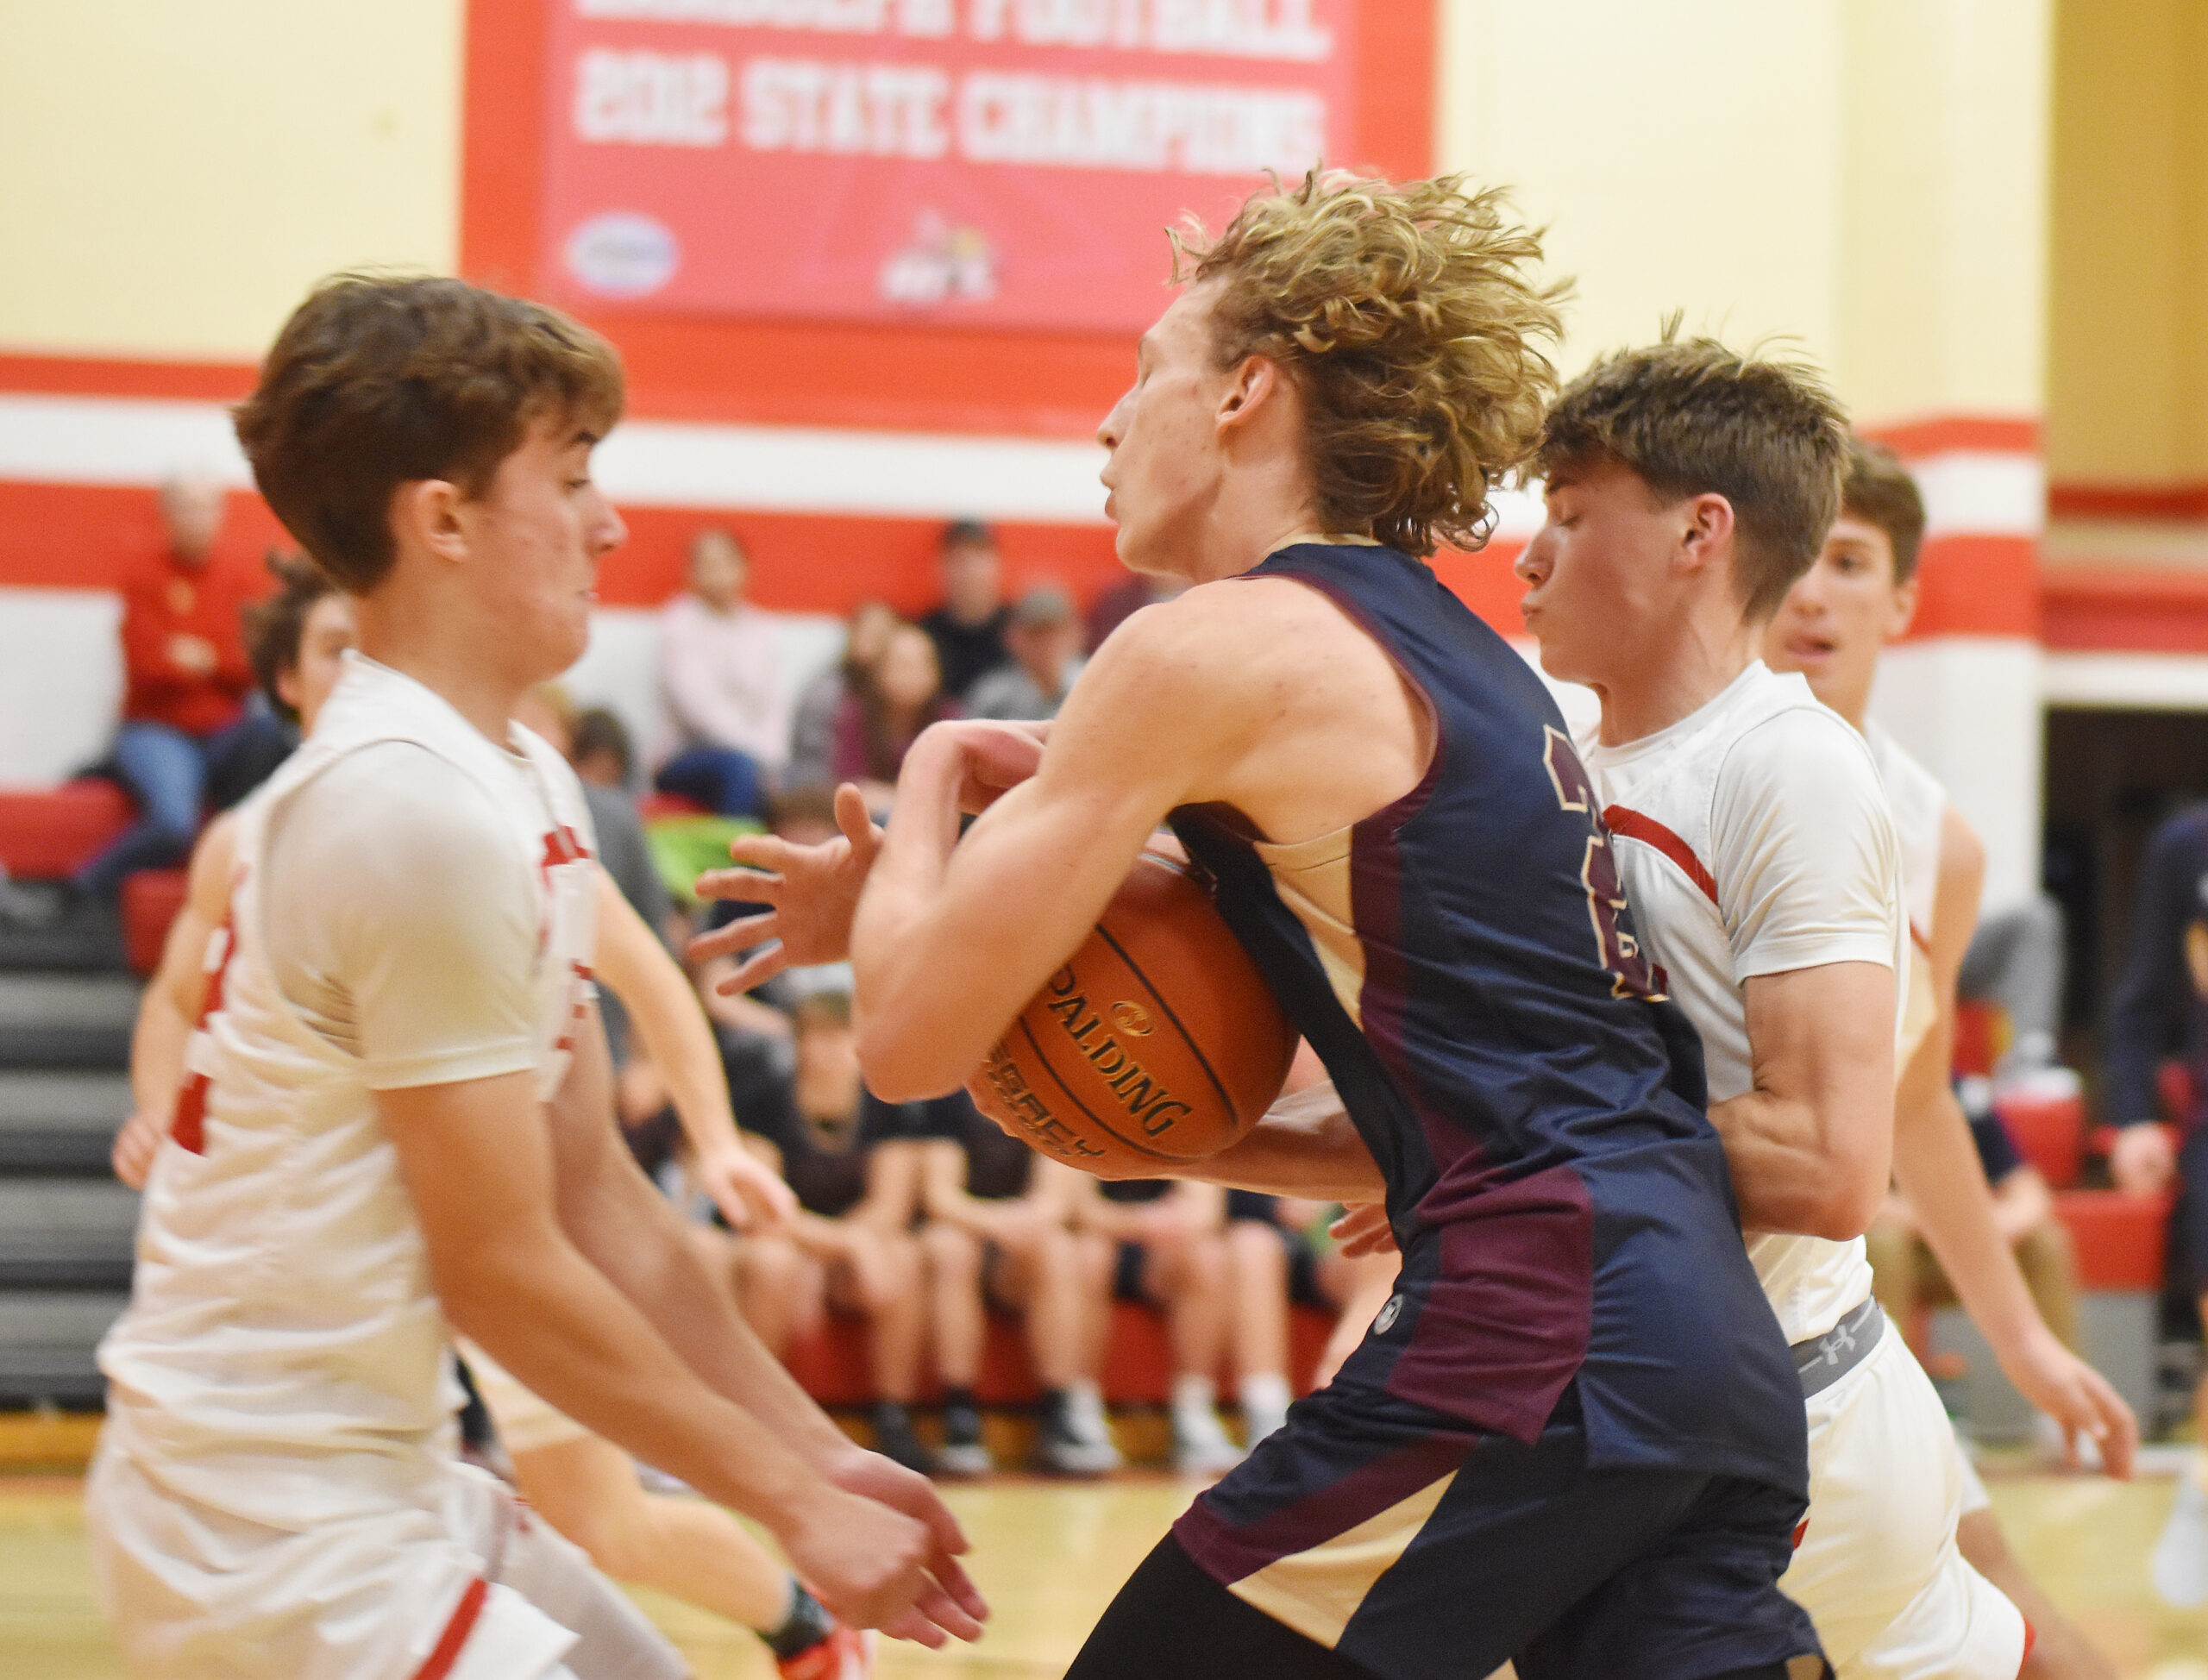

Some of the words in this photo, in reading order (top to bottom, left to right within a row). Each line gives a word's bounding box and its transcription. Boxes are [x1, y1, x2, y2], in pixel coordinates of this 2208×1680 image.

[742, 59, 948, 159] STATE
[959, 72, 1326, 176] CHAMPIONS
[1048, 963, 1193, 1138] PALDING
